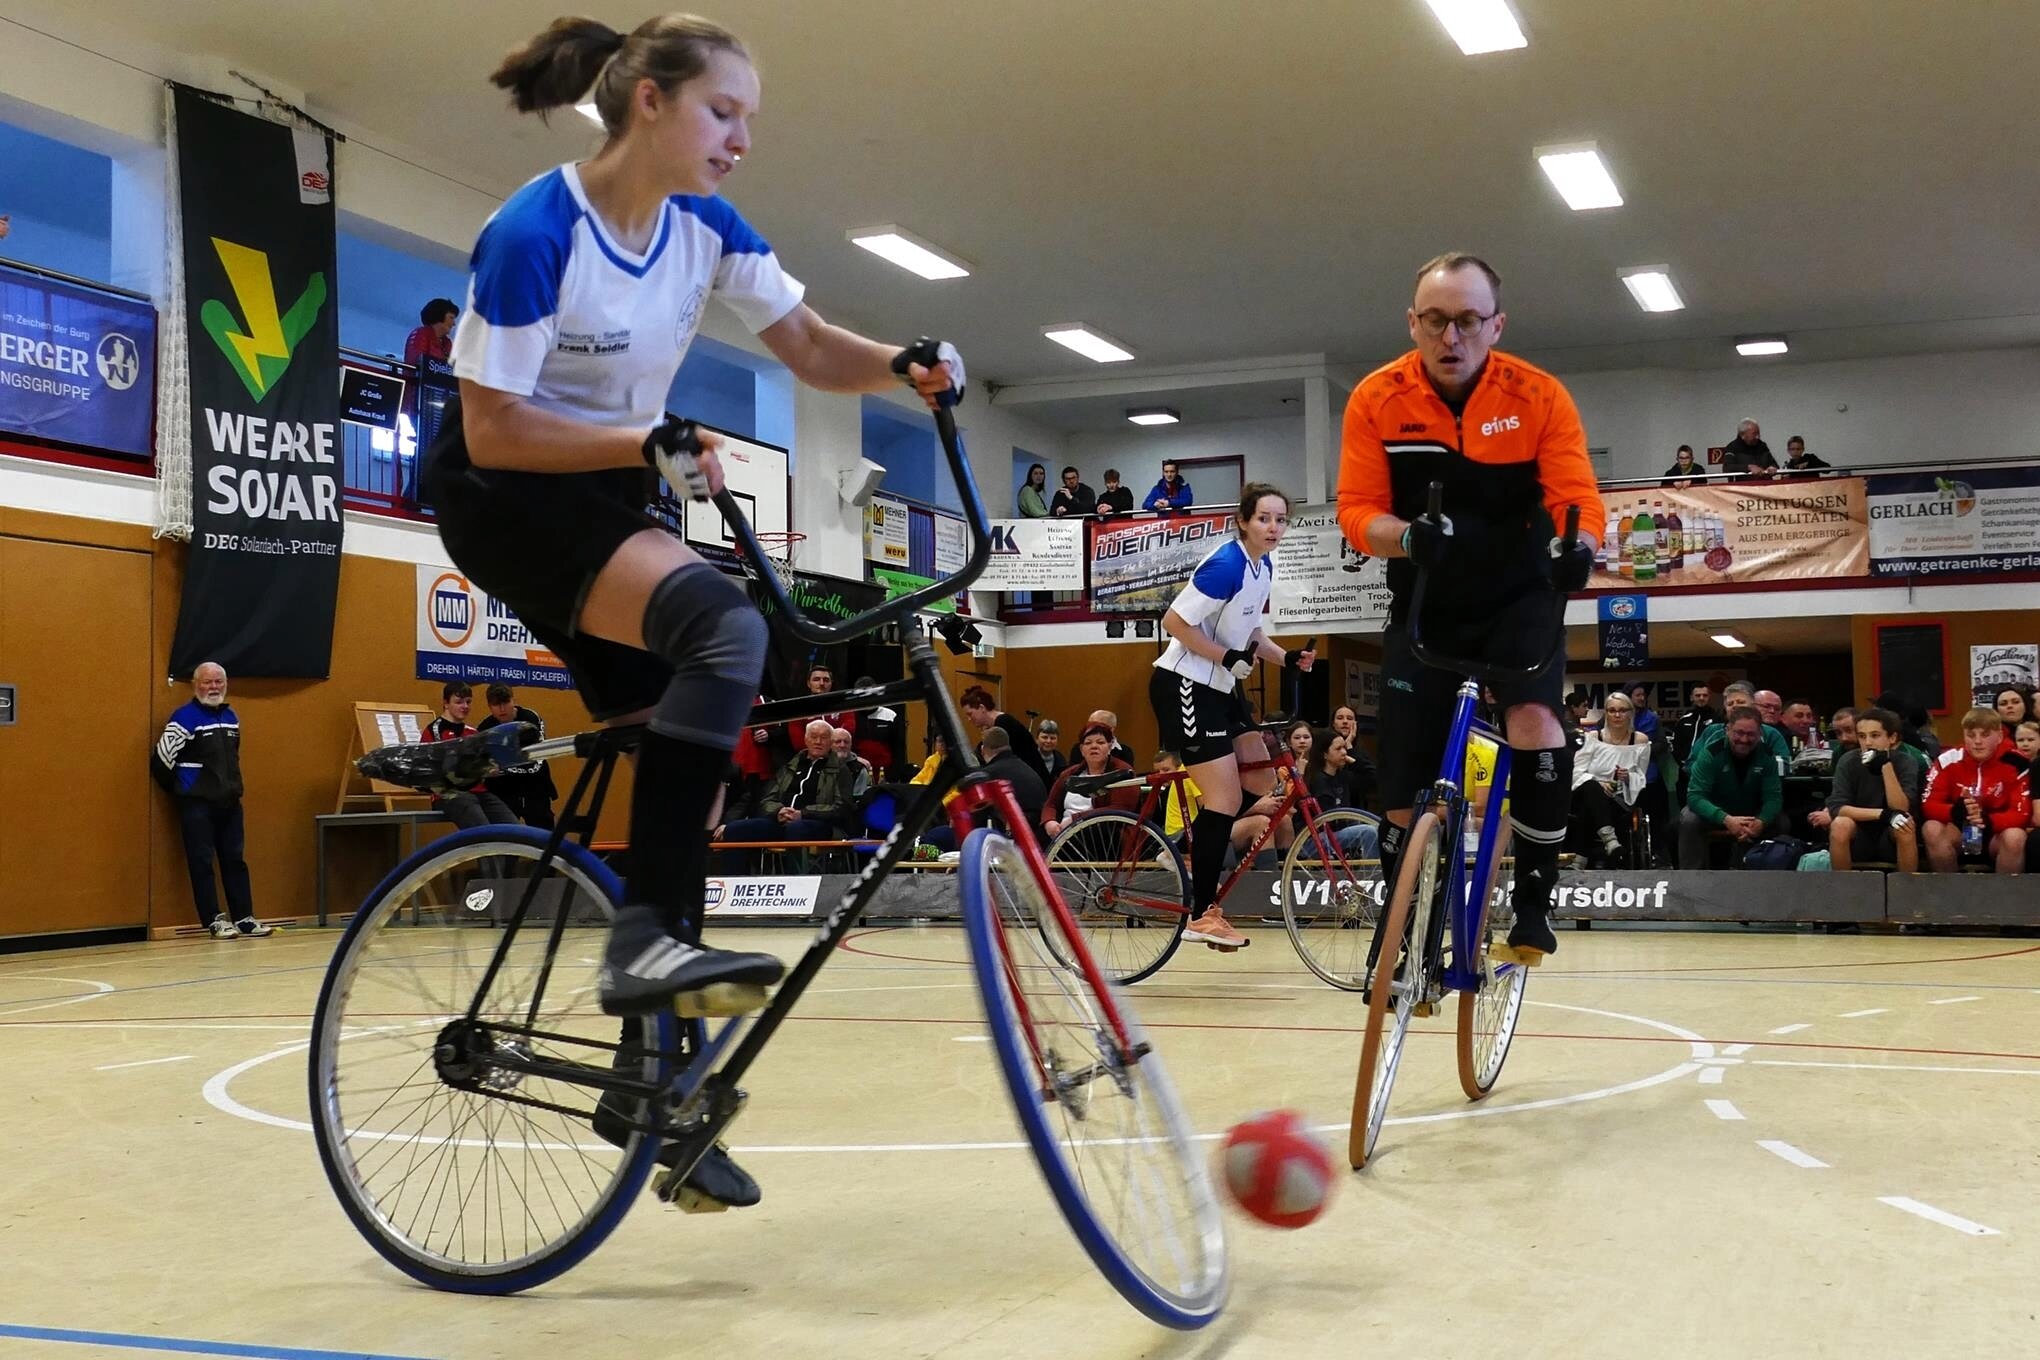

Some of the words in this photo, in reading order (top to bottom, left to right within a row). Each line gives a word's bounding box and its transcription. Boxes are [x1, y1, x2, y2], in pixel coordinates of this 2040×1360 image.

[16, 314, 51, 330] Zeichen
[53, 323, 68, 334] der
[70, 327, 90, 341] Burg
[559, 331, 595, 341] Heizung
[558, 343, 590, 353] Frank
[594, 342, 630, 353] Seidler
[1400, 424, 1426, 432] JAKO
[1481, 416, 1520, 436] eins
[207, 465, 339, 522] SOLAR
[1736, 494, 1848, 512] SPIRITUOSEN
[1870, 501, 1953, 520] GERLACH
[1097, 520, 1170, 544] RADSPORT
[1739, 534, 1758, 543] AUS
[1760, 533, 1783, 542] DEM
[1786, 529, 1850, 541] ERZGEBIRGE
[204, 533, 239, 550] DEG
[885, 546, 906, 557] weru
[1157, 573, 1180, 585] SERVICE
[1302, 594, 1356, 604] Putzarbeiten
[438, 597, 466, 624] MM
[1279, 606, 1362, 617] Fliesenlegearbeiten
[427, 663, 460, 675] DREHEN
[467, 664, 494, 677] HÄRTEN
[500, 667, 526, 680] FRÄSEN
[531, 671, 567, 683] SCHLEIFEN
[733, 884, 786, 896] MEYER
[730, 898, 808, 907] DREHTECHNIK
